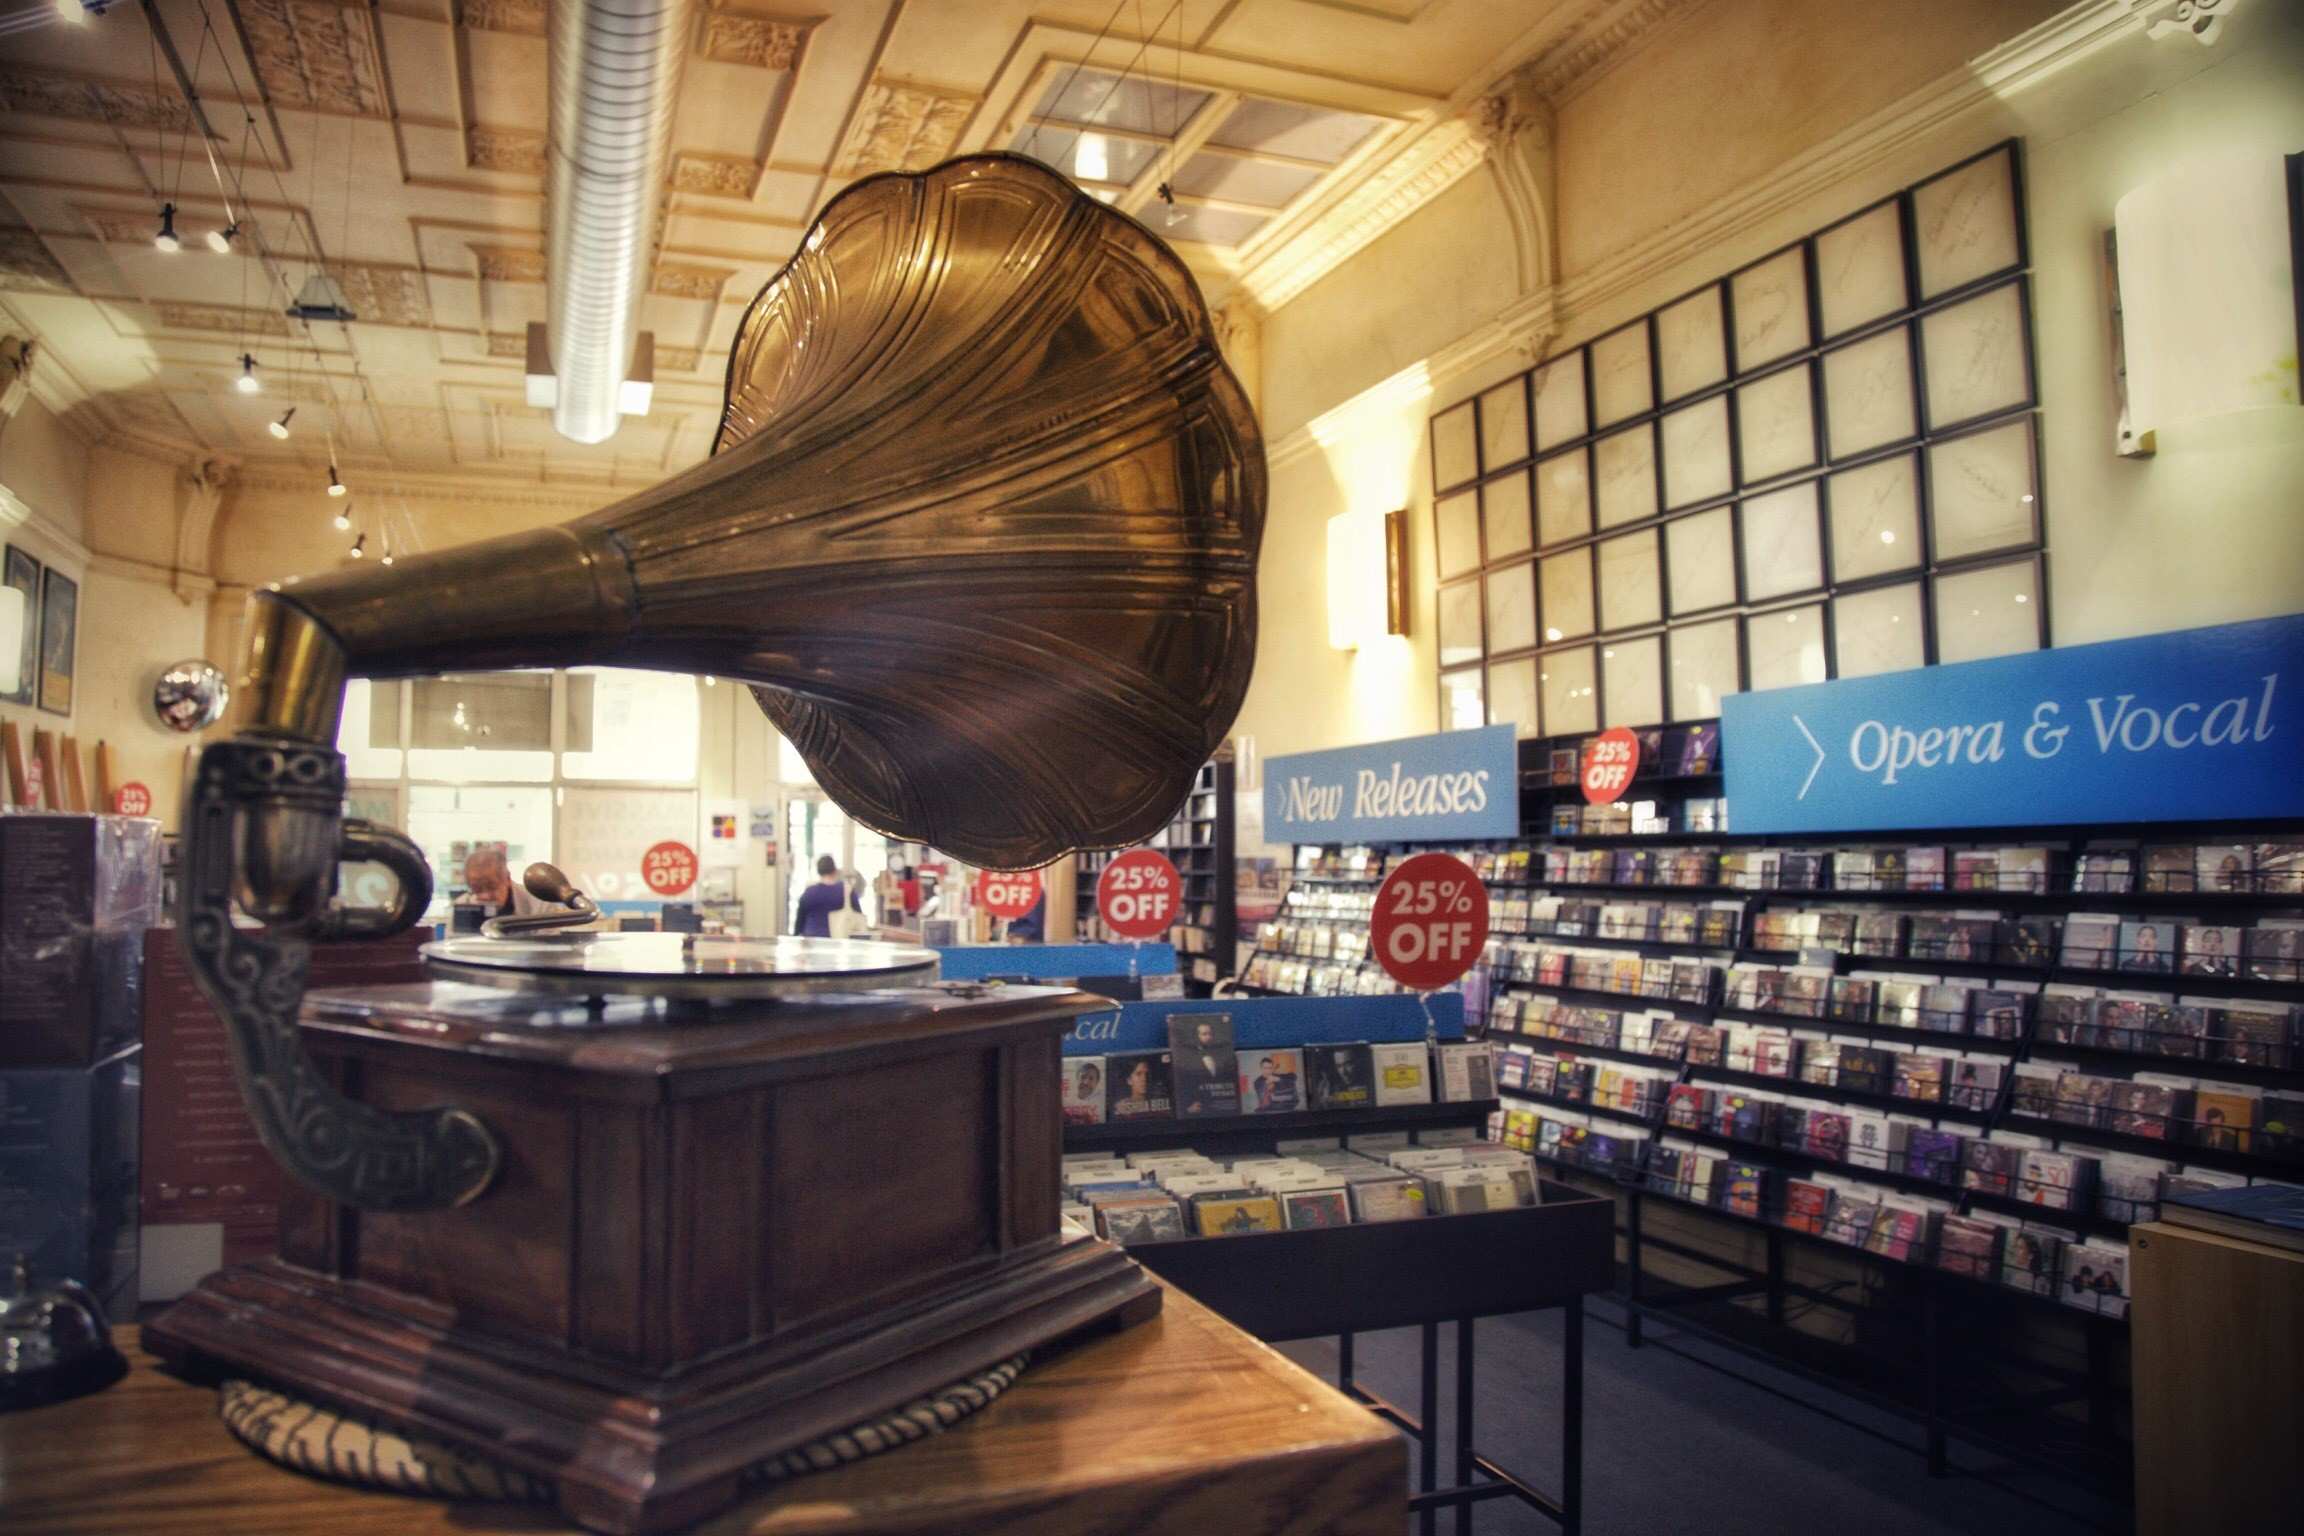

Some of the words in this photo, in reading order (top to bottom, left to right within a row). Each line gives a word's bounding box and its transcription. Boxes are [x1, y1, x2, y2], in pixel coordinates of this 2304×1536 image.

[1849, 720, 2005, 785] Opera
[2023, 701, 2071, 760] &
[2087, 673, 2279, 754] Vocal
[1593, 741, 1632, 763] 25%
[1587, 764, 1629, 790] OFF
[1284, 775, 1344, 823] New
[1353, 761, 1490, 819] Releases
[649, 850, 691, 867] 25%
[649, 867, 691, 887] OFF
[1110, 866, 1169, 891] 25%
[986, 883, 1033, 907] OFF
[1109, 894, 1169, 922] OFF
[1390, 881, 1473, 915] 25%
[1388, 922, 1473, 964] OFF
